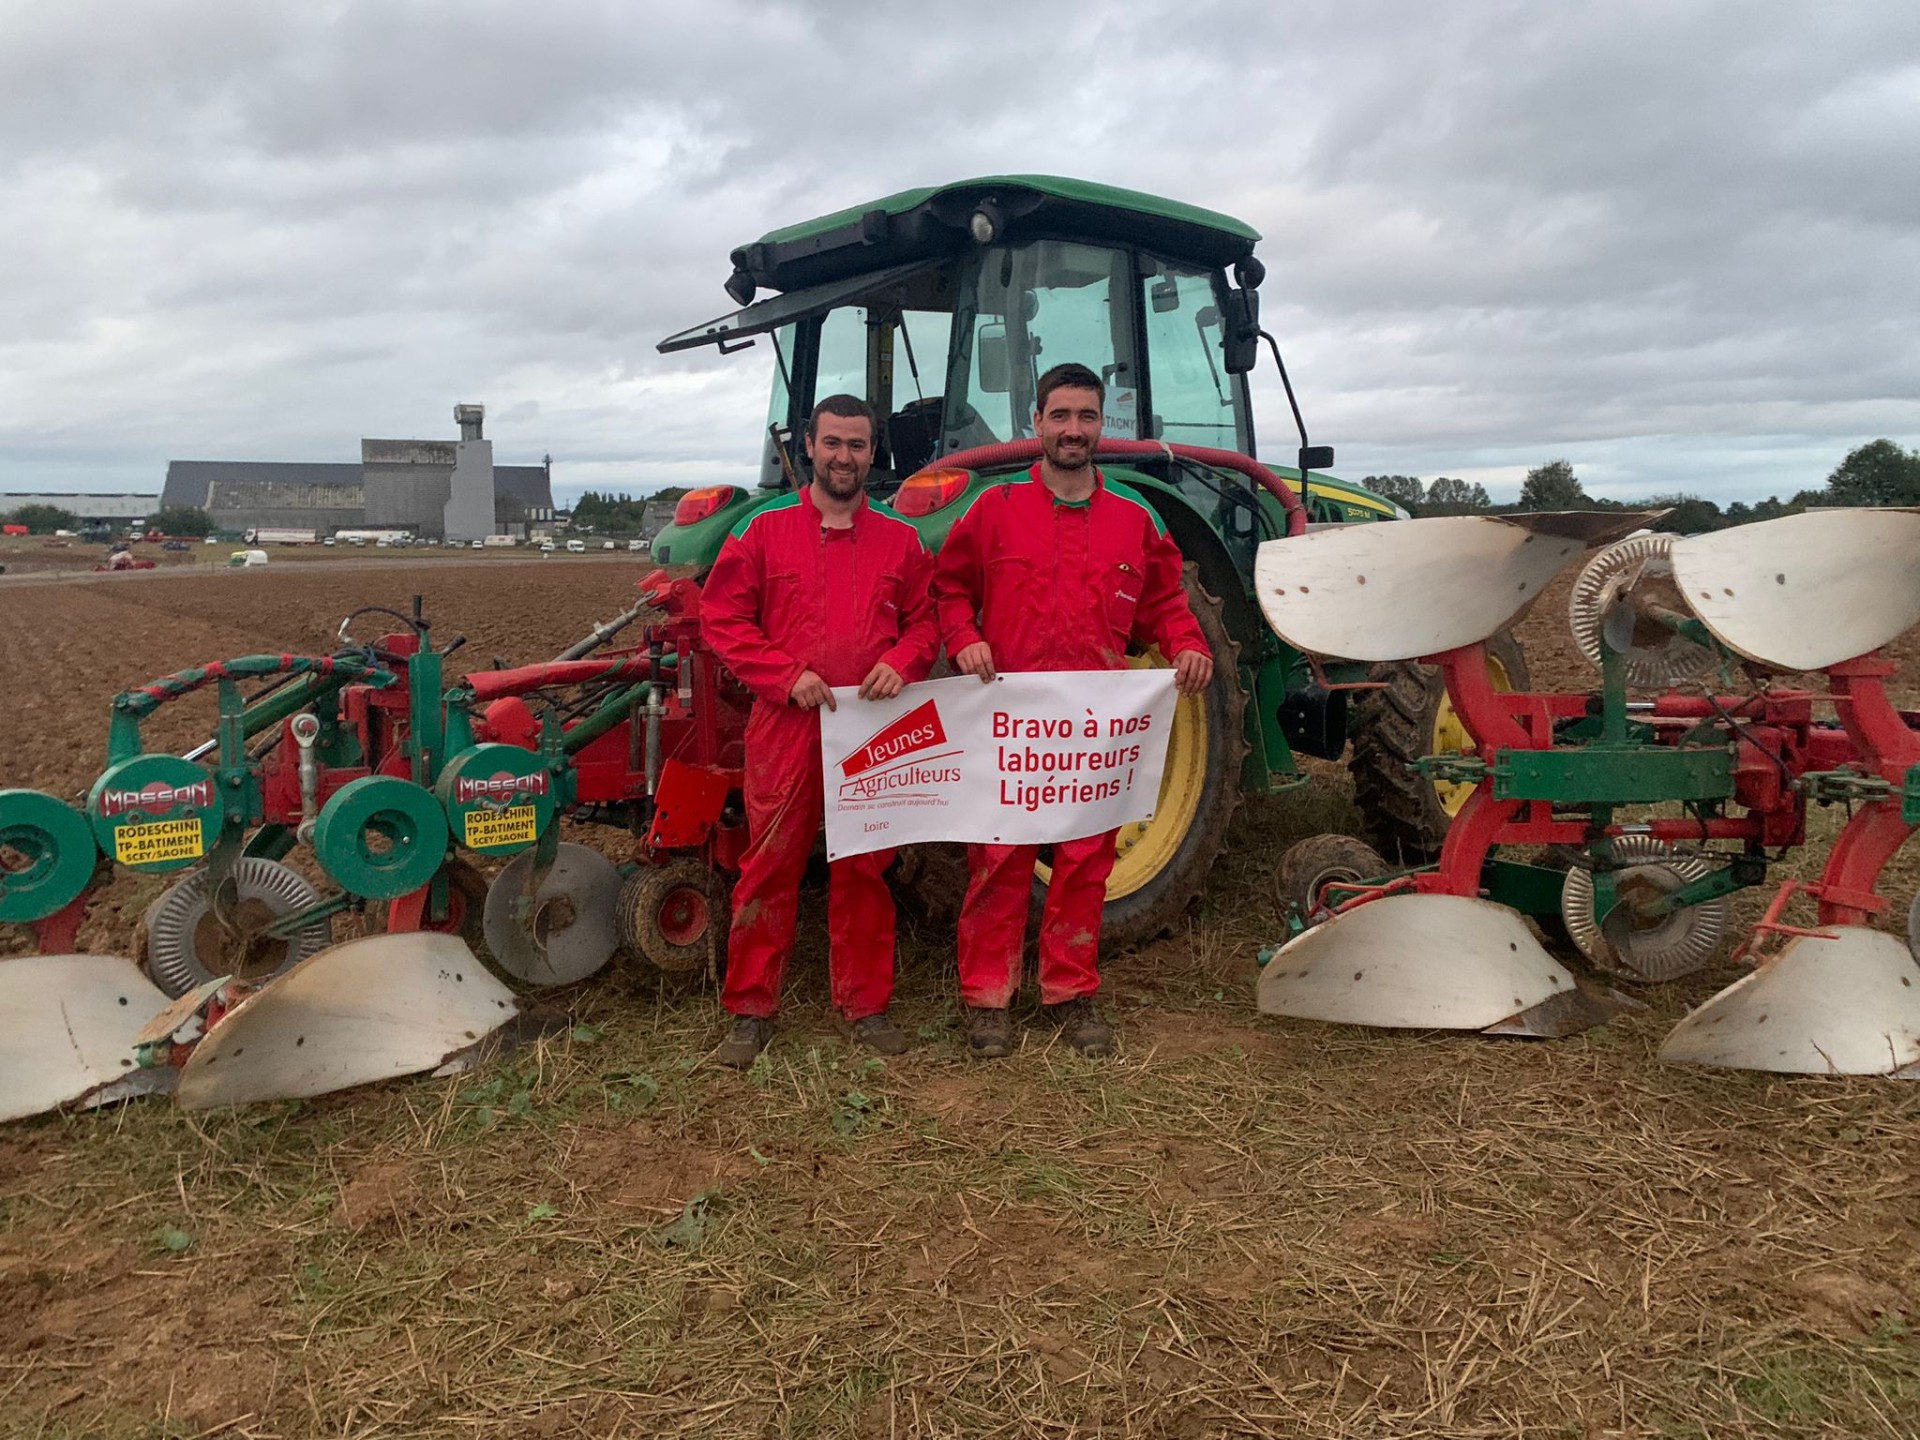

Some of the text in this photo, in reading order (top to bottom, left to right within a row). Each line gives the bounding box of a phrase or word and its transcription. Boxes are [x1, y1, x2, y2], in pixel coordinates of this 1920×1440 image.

[1102, 415, 1136, 430] TAGNY
[993, 707, 1152, 738] Bravo à nos
[864, 723, 935, 768] Jeunes
[998, 745, 1140, 772] laboureurs
[460, 773, 543, 802] MASSON
[852, 767, 961, 797] Agriculteurs
[1000, 768, 1134, 812] Ligériens !
[105, 783, 207, 817] MASSON
[837, 803, 866, 811] Demain
[118, 820, 199, 839] RODESCHINI
[467, 820, 534, 836] TP-BATIMENT
[864, 820, 889, 832] Loire
[118, 834, 200, 852] TP-BATIMENT
[473, 831, 529, 846] SCEY/SAONE
[126, 847, 194, 862] SCEY/SAONE
